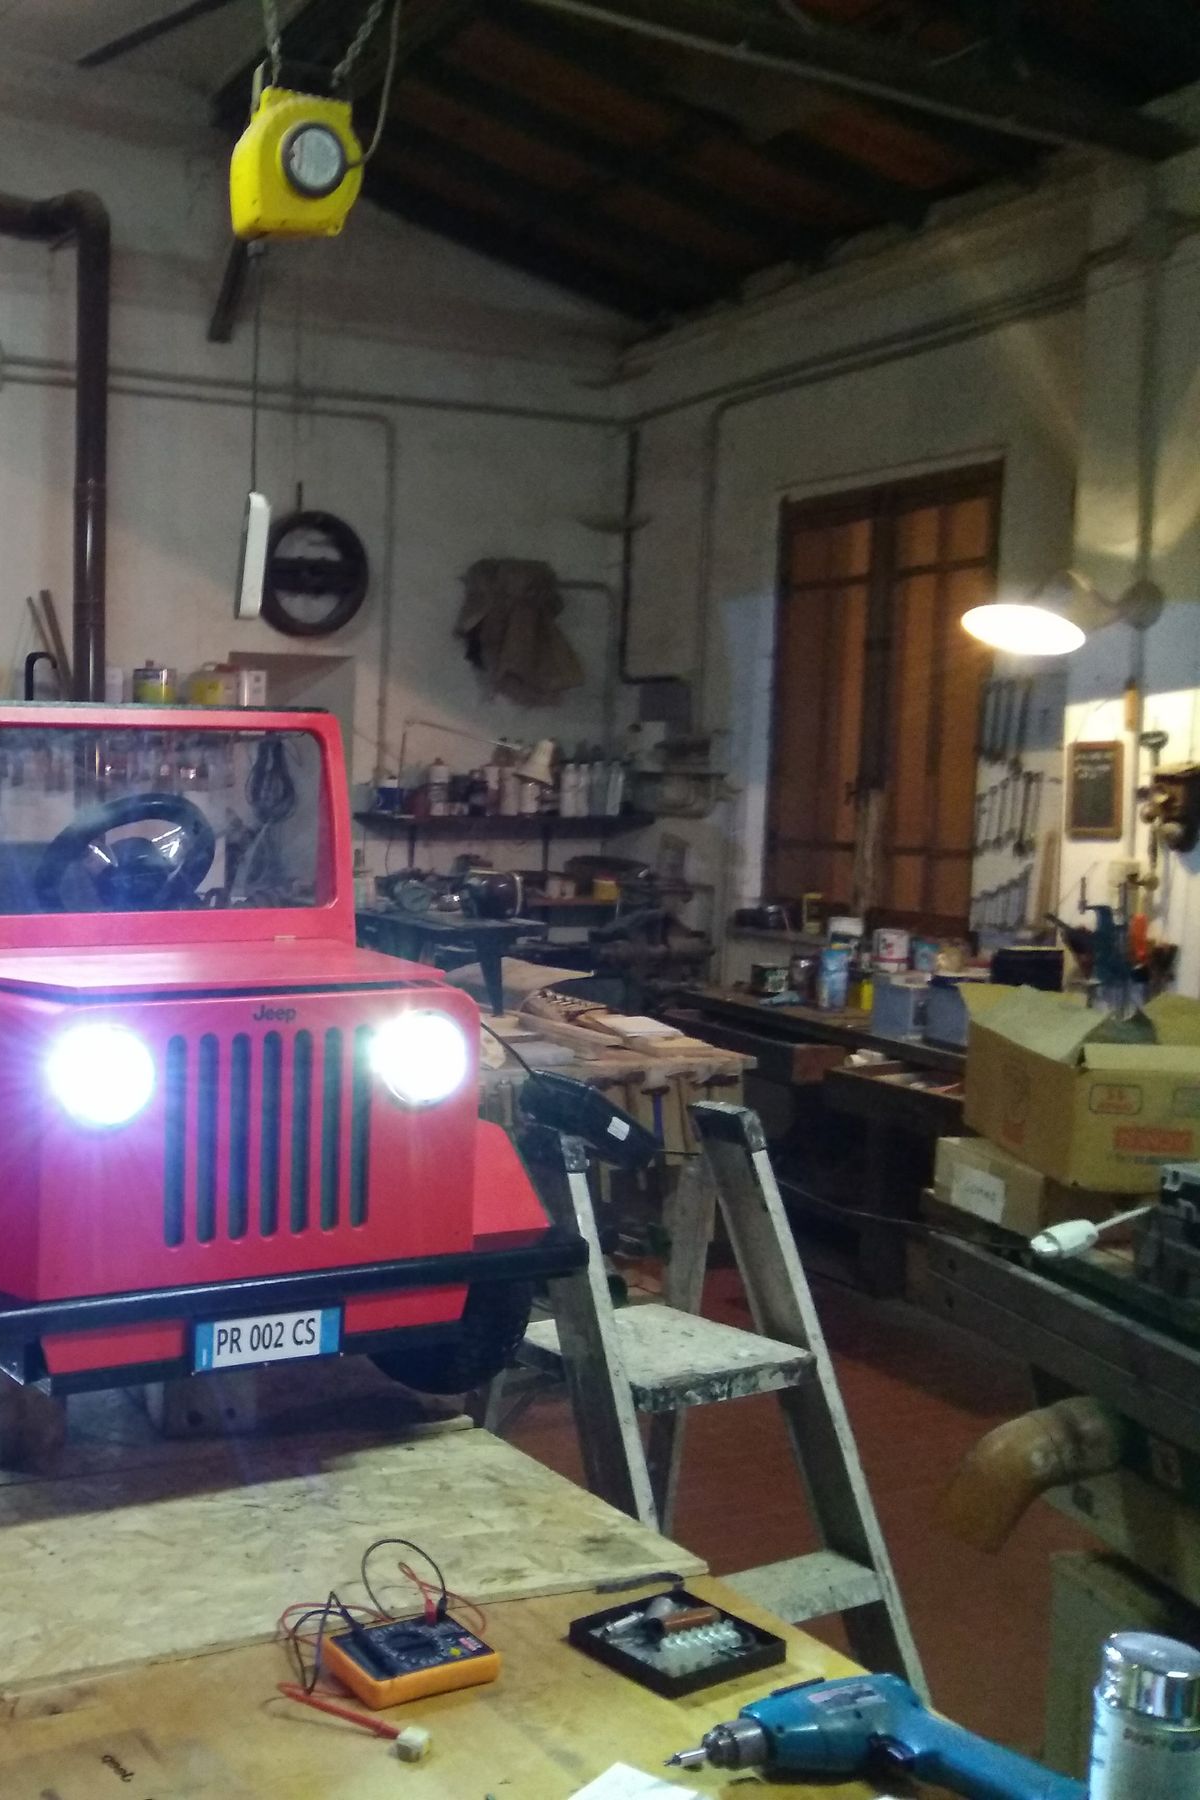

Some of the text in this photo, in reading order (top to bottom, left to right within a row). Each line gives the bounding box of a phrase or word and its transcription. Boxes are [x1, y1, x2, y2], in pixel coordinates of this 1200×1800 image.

[253, 1004, 297, 1024] Jeep
[216, 1317, 316, 1356] PR 002 CS
